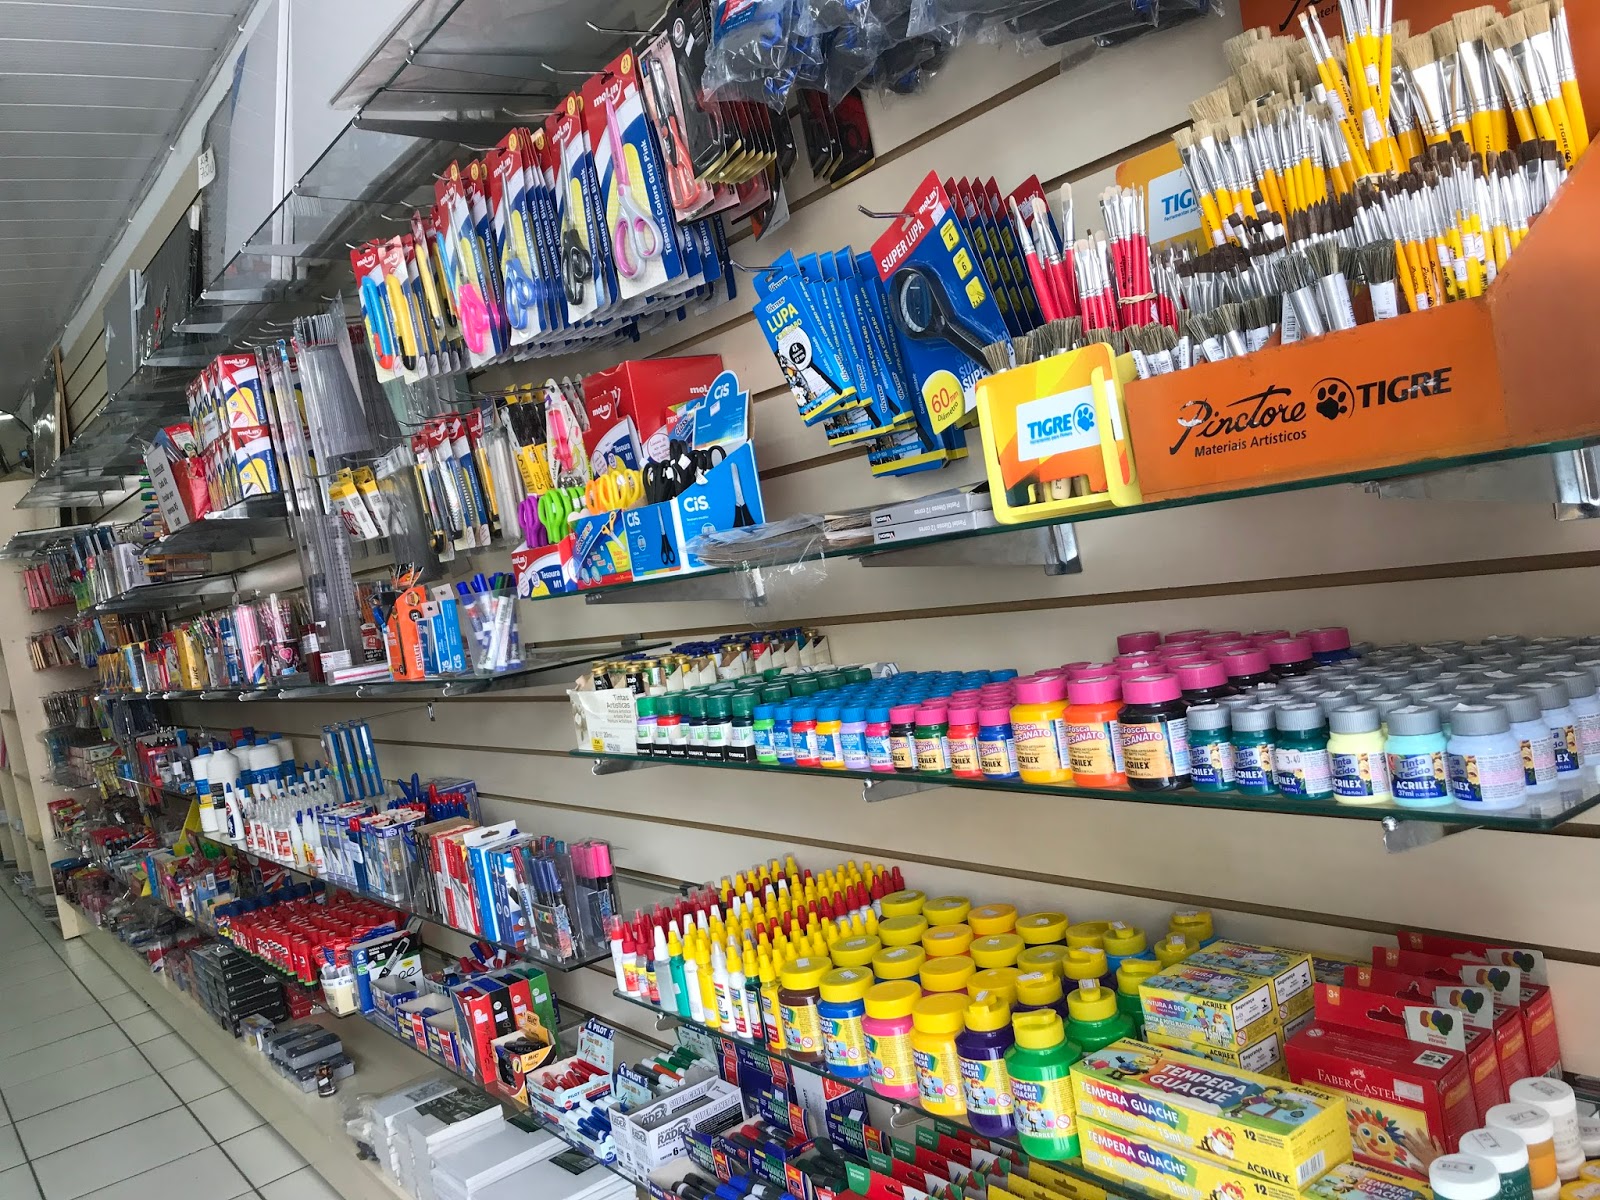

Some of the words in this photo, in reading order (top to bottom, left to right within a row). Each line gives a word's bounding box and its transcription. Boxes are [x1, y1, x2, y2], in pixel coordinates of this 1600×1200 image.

[641, 140, 650, 162] Pink
[580, 167, 588, 195] Black
[588, 166, 596, 193] Black
[646, 163, 655, 184] Grip
[593, 194, 602, 220] Office
[651, 184, 664, 216] Colors
[1161, 188, 1195, 215] TIG
[600, 222, 609, 256] Tesoura
[659, 218, 672, 255] Tesoura
[881, 242, 910, 274] SUPER
[905, 218, 926, 250] LUPA
[766, 302, 799, 333] LUPA
[865, 343, 874, 359] COM
[871, 359, 879, 376] LUPA
[1356, 367, 1452, 409] TIGRE
[1027, 413, 1073, 440] TIGRE
[613, 442, 631, 454] Tesoura
[1194, 439, 1247, 458] Materiais
[1250, 428, 1307, 448] Artísticos
[540, 569, 561, 580] Tesoura
[1332, 758, 1352, 766] Tinta
[1401, 759, 1426, 768] Tinta
[1399, 767, 1431, 778] Tecido
[1396, 780, 1437, 789] ACRILEX
[1359, 972, 1370, 981] 3+
[1328, 989, 1339, 998] 3+
[1202, 1000, 1227, 1010] ACRILEX
[1235, 997, 1255, 1010] Segurança
[592, 1023, 608, 1036] PILOT
[1209, 1049, 1235, 1059] ACRILEX
[1242, 1047, 1262, 1060] Segurança
[625, 1071, 642, 1083] PILOT
[1162, 1064, 1247, 1096] TEMPERA
[1149, 1074, 1233, 1104] GUACHE
[1292, 1086, 1331, 1101] ACRILEX
[1081, 1081, 1129, 1108] TEMPERA
[1130, 1099, 1180, 1124] GUACHE
[641, 1107, 668, 1127] ADEX
[692, 1108, 711, 1121] SUPER
[1243, 1128, 1257, 1141] 12
[672, 1148, 679, 1156] 6
[1087, 1130, 1136, 1159] TEMPERA
[1137, 1151, 1188, 1177] GUACHE
[1247, 1161, 1291, 1184] ACRILEX
[1253, 1182, 1268, 1196] 12
[1361, 1176, 1414, 1197] TEMPERA
